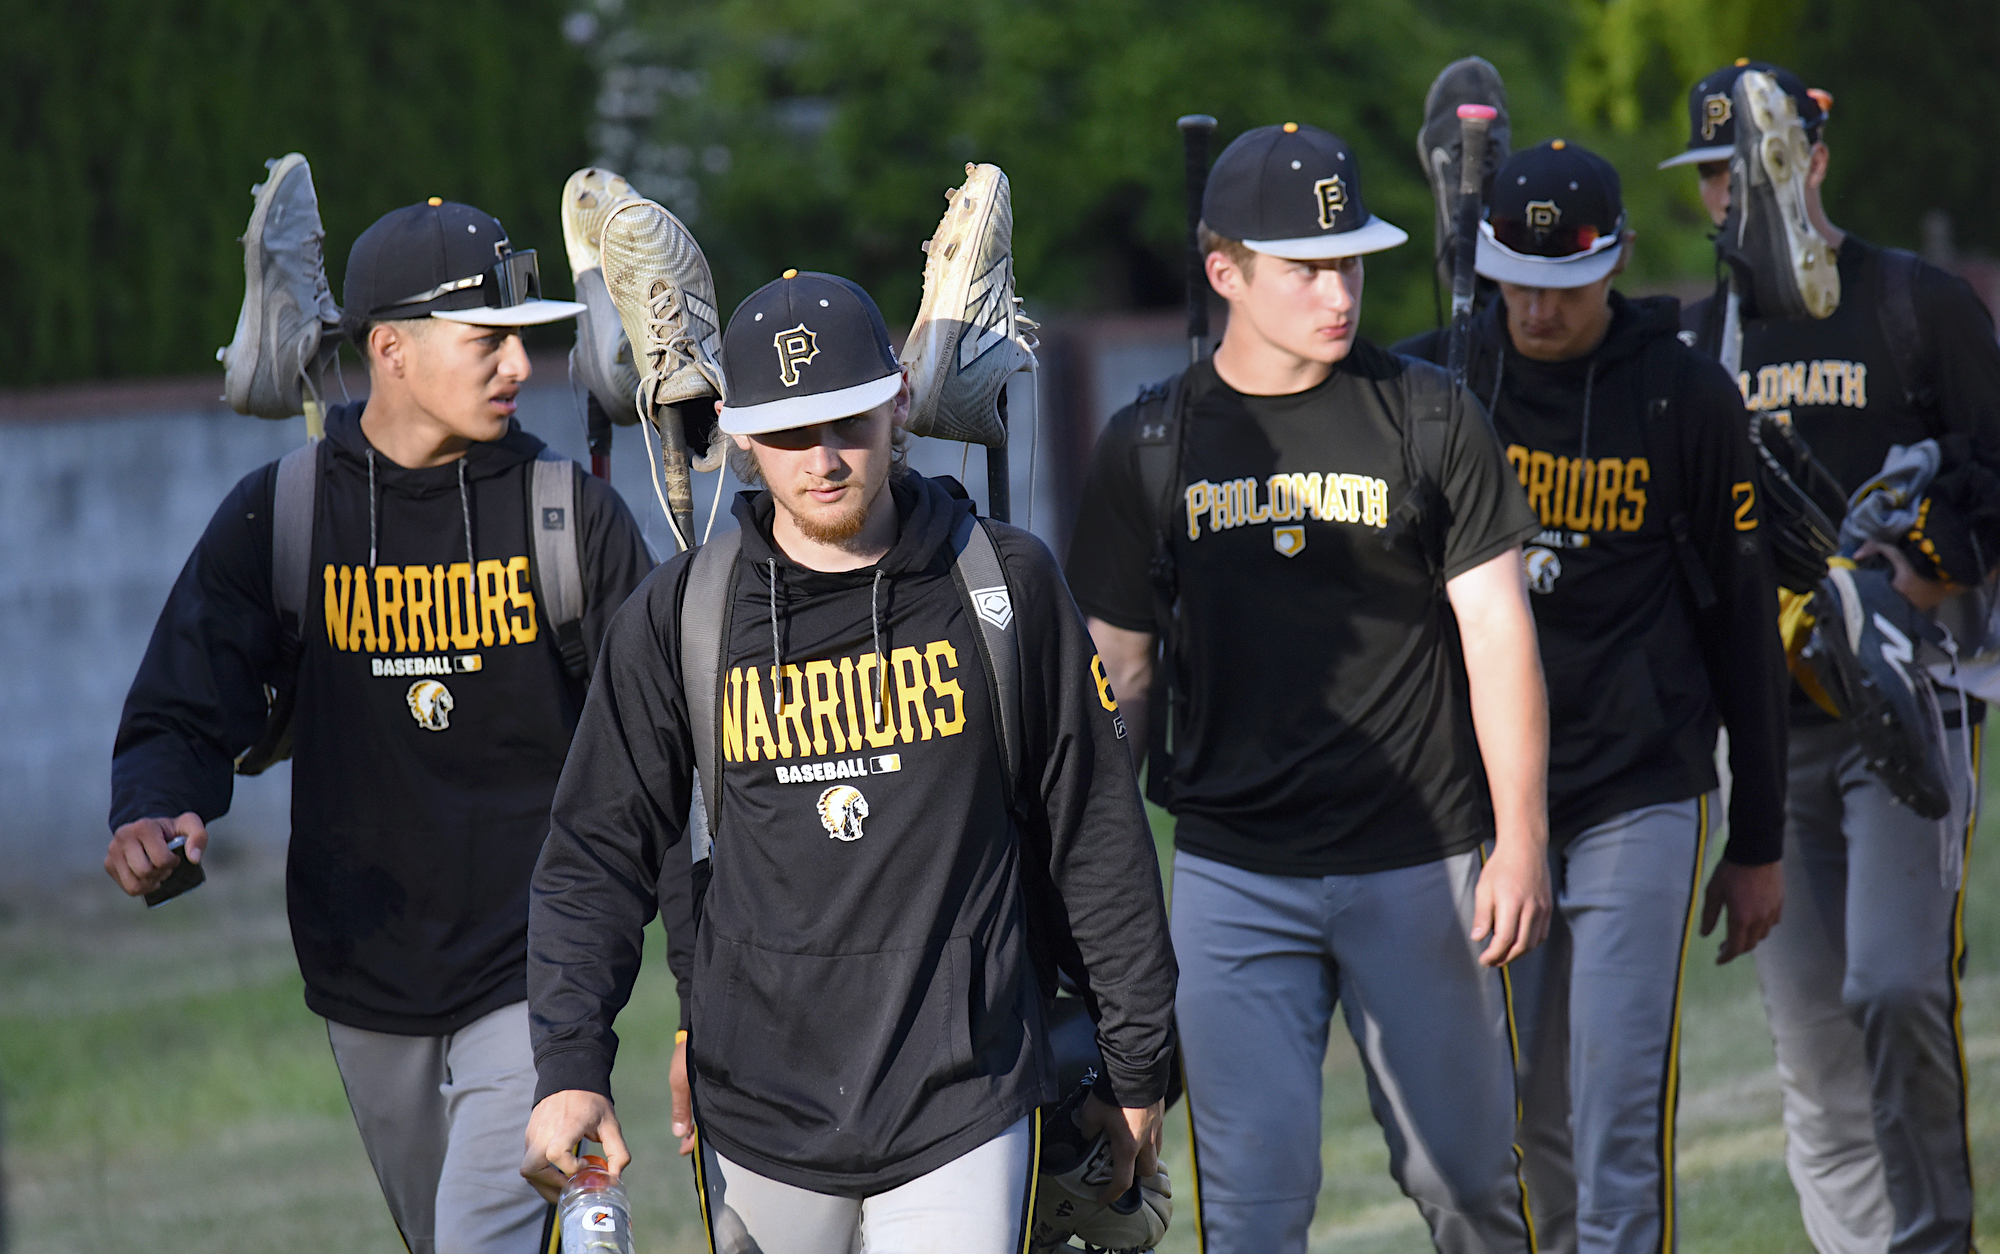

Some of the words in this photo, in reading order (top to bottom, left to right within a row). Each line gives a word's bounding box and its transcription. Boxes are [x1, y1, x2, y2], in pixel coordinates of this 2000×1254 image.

[1701, 91, 1733, 140] P
[1313, 173, 1349, 230] P
[773, 322, 821, 388] P
[1185, 471, 1389, 541] PHILOMATH
[1731, 480, 1759, 532] 2
[371, 656, 452, 677] BASEBALL
[775, 757, 868, 784] BASEBALL
[581, 1205, 616, 1232] G
